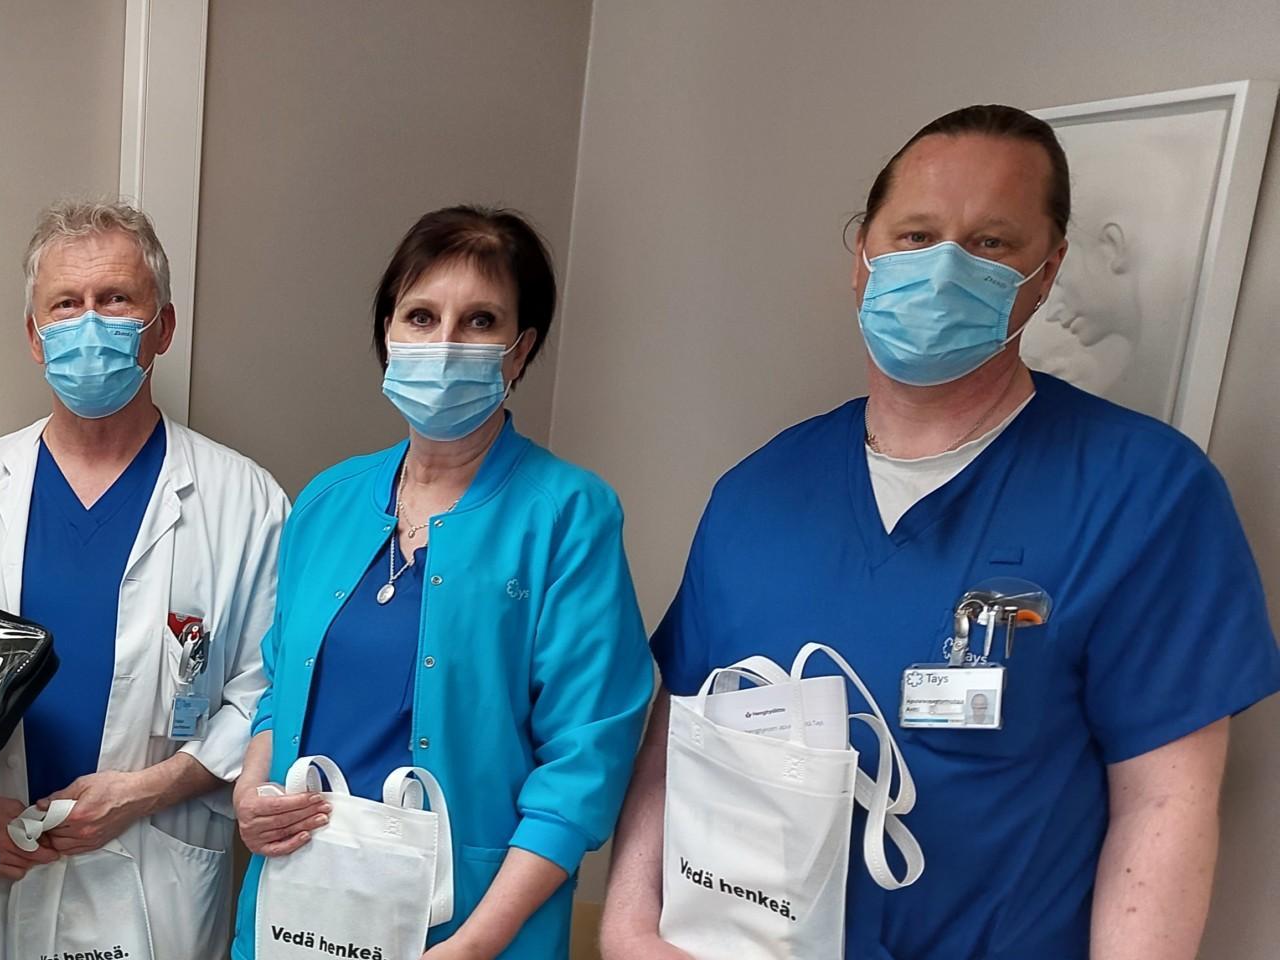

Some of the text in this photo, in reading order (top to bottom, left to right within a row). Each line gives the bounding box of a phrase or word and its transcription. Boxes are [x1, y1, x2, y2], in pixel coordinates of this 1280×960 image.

[926, 673, 949, 686] Tays
[680, 856, 796, 921] Vedä henkeä.
[271, 925, 315, 948] Vedä
